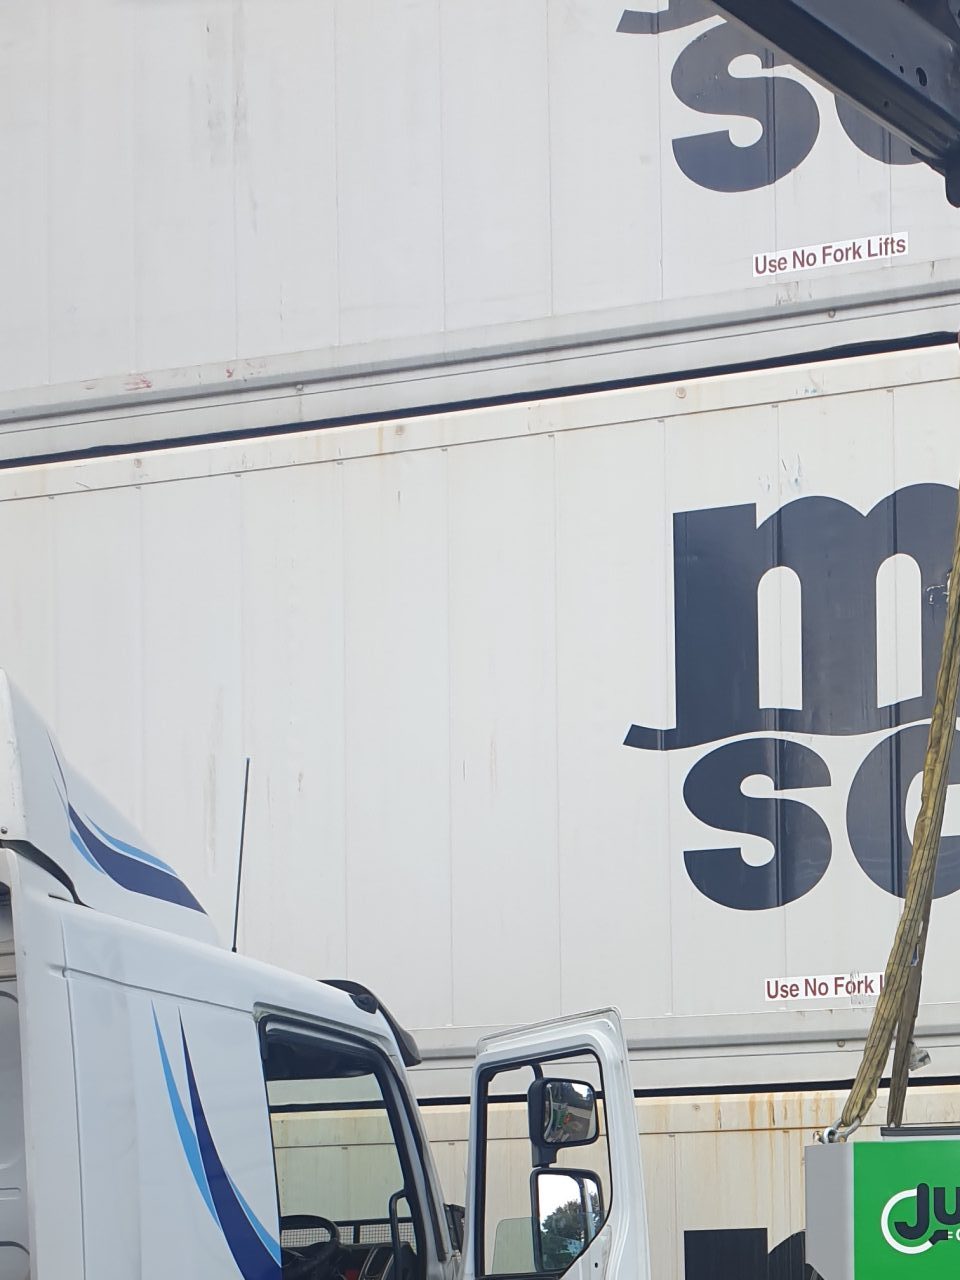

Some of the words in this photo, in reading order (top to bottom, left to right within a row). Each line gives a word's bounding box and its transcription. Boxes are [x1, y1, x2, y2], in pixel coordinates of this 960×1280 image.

[755, 255, 788, 275] Use
[792, 249, 817, 269] No
[822, 241, 862, 265] Fork
[867, 236, 906, 258] Lifts
[766, 980, 800, 999] Use
[804, 978, 829, 996] No
[834, 975, 875, 996] Fork
